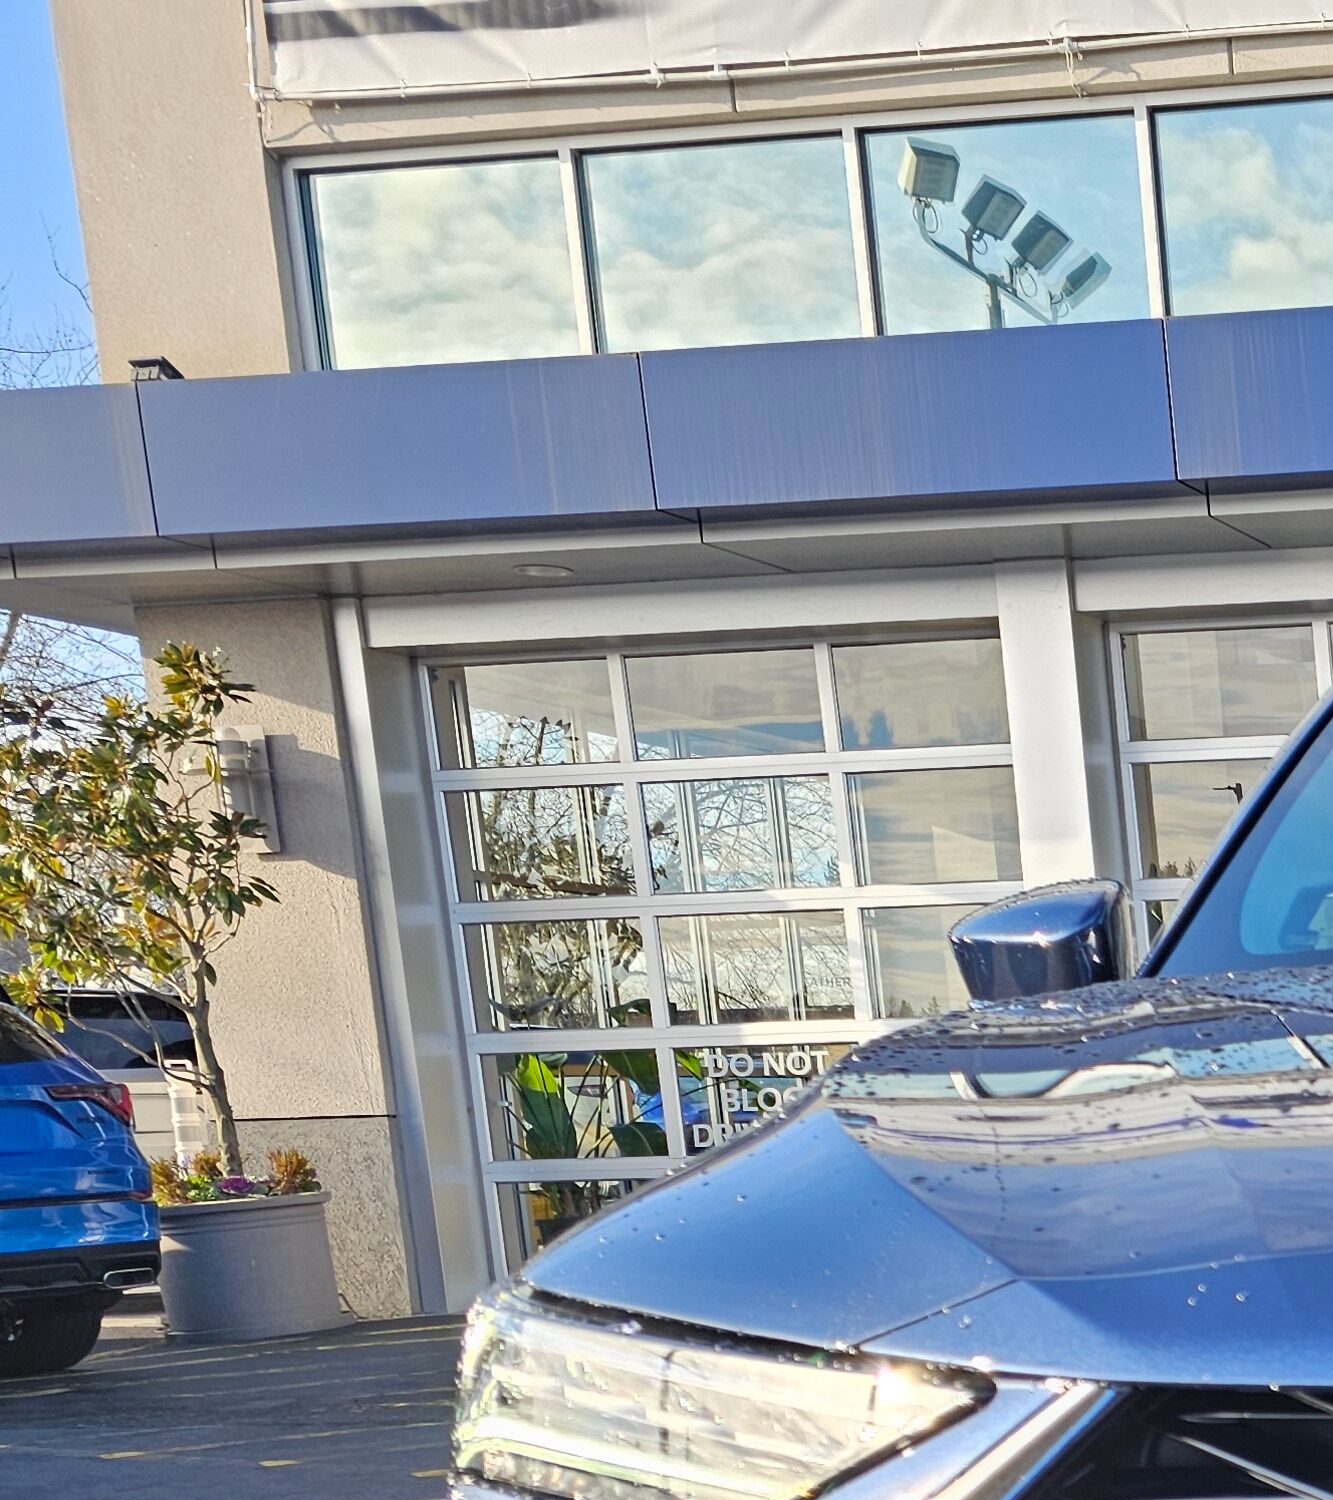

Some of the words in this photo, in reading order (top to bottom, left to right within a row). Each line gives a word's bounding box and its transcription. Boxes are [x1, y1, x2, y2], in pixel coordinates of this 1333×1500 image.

[805, 976, 853, 988] ATHER
[707, 1053, 753, 1078] DO
[762, 1050, 829, 1076] NOT
